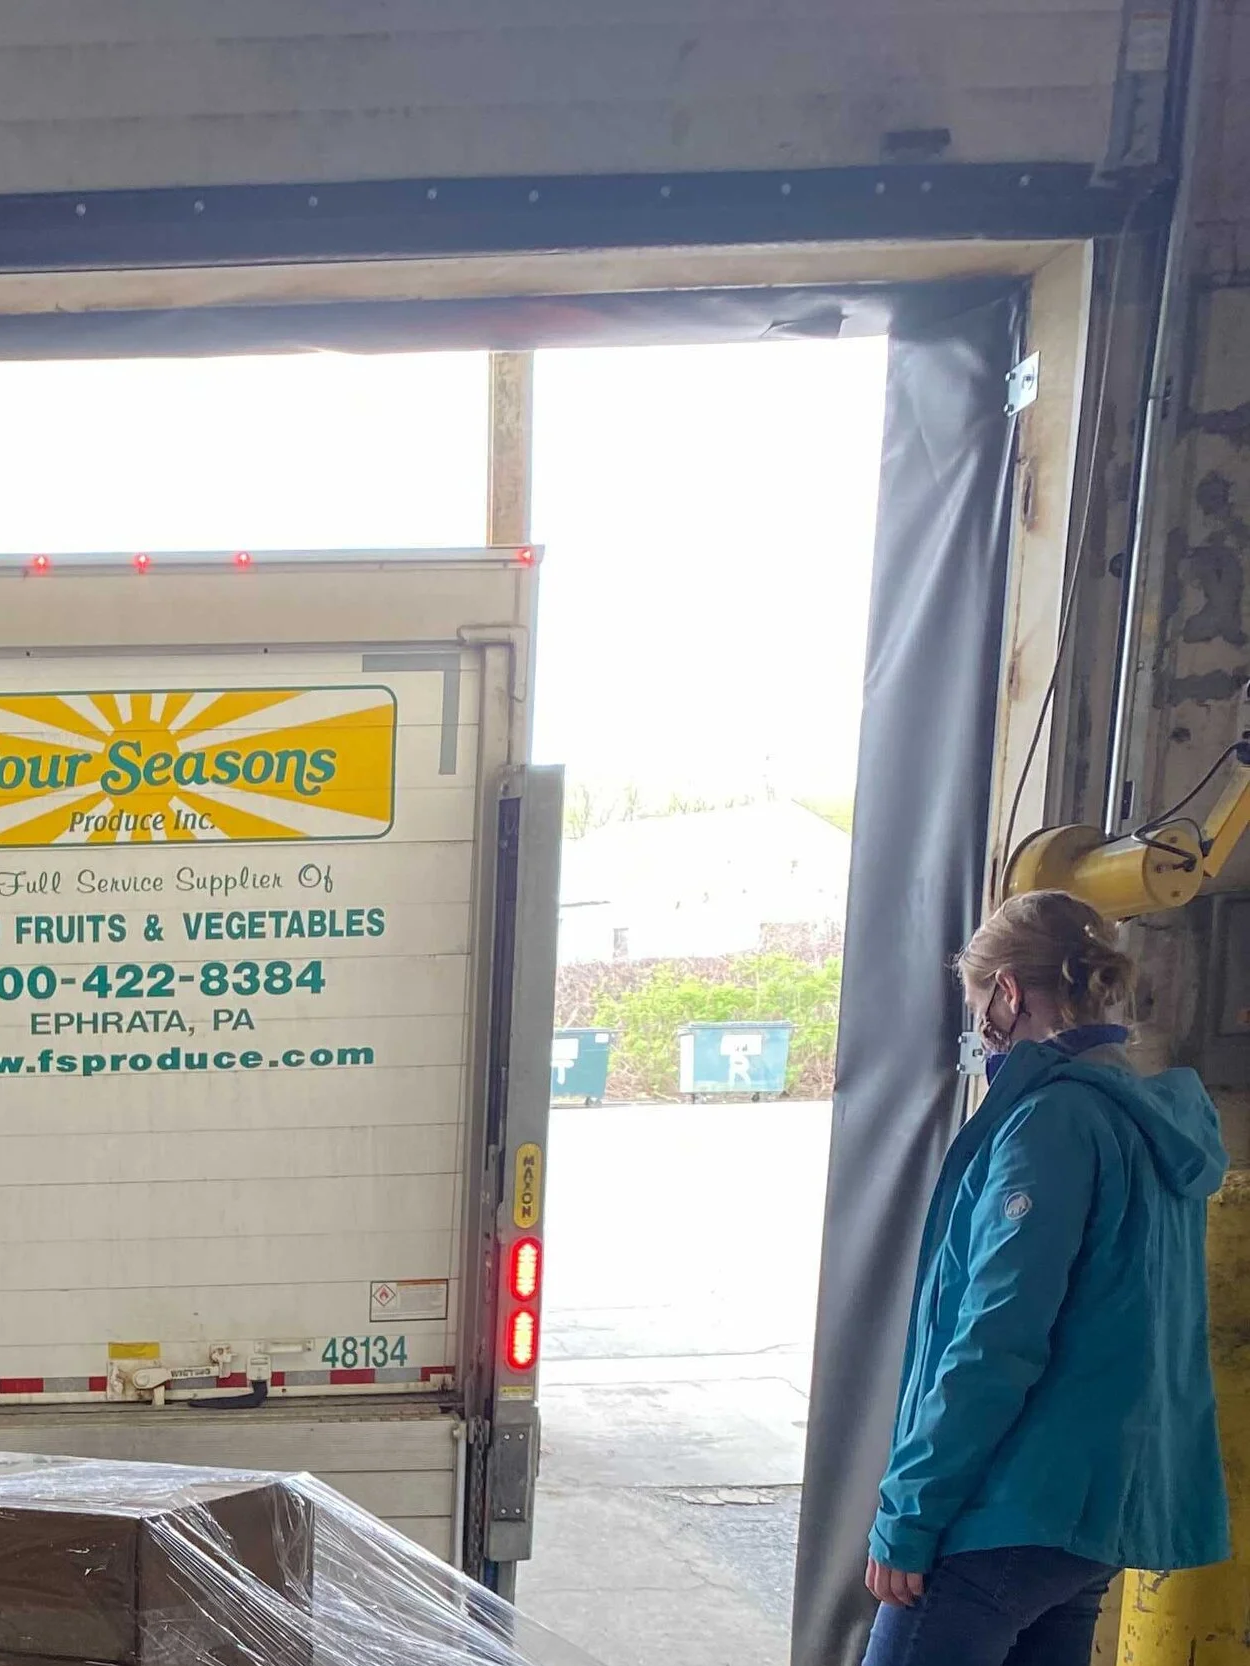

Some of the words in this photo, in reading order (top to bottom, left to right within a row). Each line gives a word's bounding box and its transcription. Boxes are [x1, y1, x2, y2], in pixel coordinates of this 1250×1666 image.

[98, 740, 338, 797] Seasons
[69, 808, 165, 834] Produce
[173, 809, 216, 831] Inc.
[76, 869, 164, 894] Service
[175, 866, 284, 897] Supplier
[298, 864, 334, 894] Of
[15, 914, 128, 945] FRUITS
[144, 914, 164, 942] &
[182, 908, 386, 940] VEGETABLES
[30, 1010, 196, 1037] EPHRATA,
[213, 1008, 255, 1032] PA
[521, 1155, 535, 1218] MAXON
[322, 1335, 408, 1368] 48134
